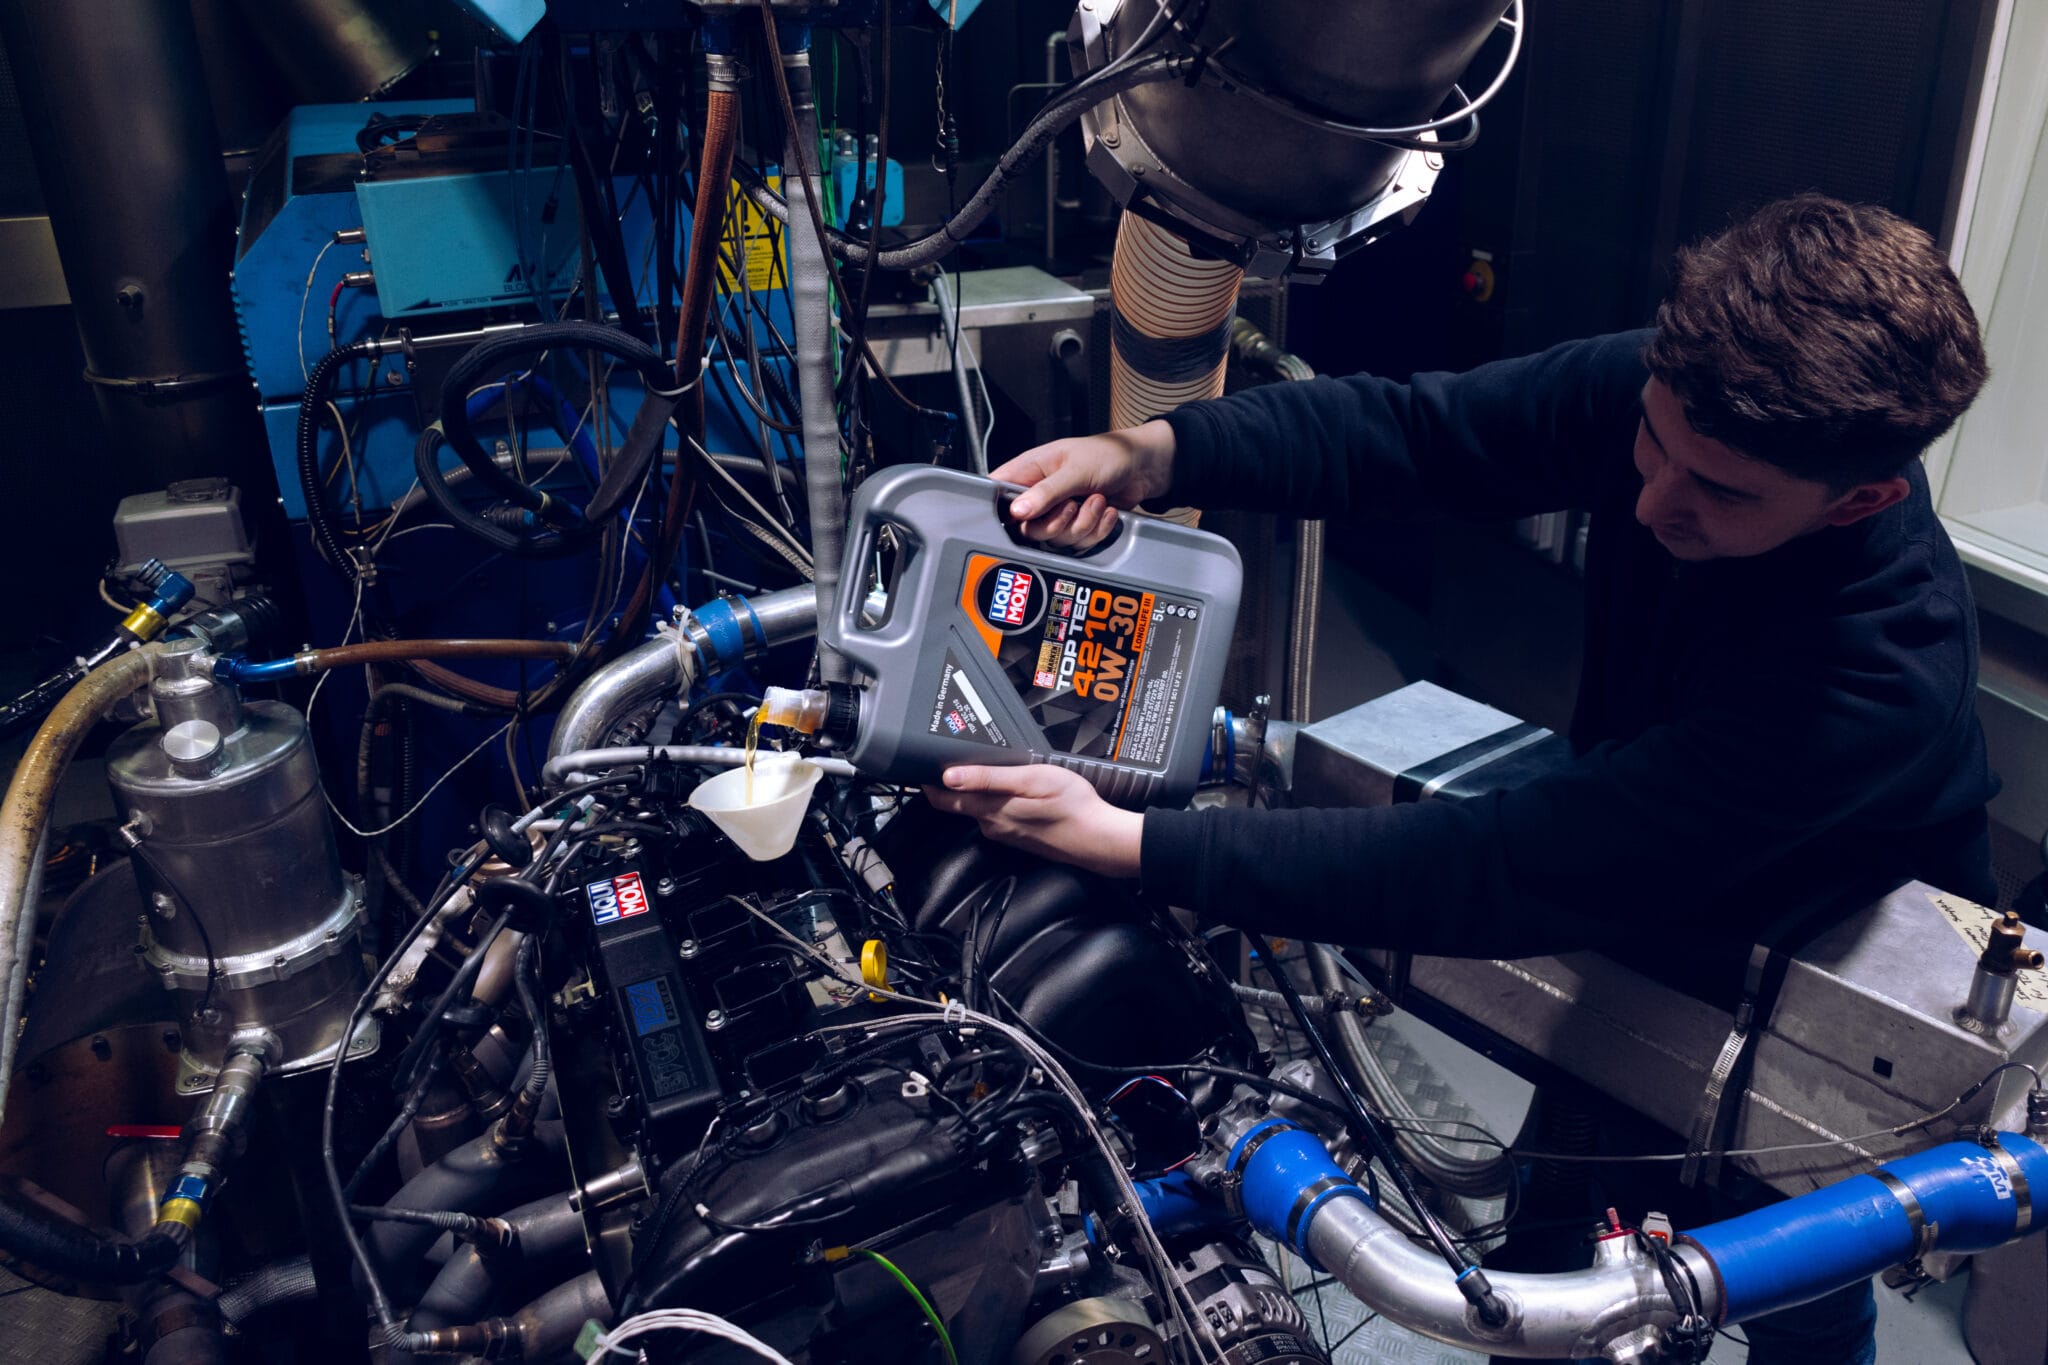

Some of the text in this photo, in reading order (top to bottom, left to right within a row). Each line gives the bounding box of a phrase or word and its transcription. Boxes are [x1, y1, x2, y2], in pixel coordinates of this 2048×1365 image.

[990, 571, 1015, 619] LIQUI
[1007, 574, 1030, 622] MOLY
[1055, 639, 1079, 692] TOP
[1068, 585, 1091, 636] TEC
[1073, 589, 1112, 698] 4210
[1134, 597, 1151, 648] LONGLIFE III
[1094, 596, 1139, 701] 0W-30
[929, 663, 954, 732] Made in Germany
[950, 710, 965, 729] MOLY
[960, 711, 970, 723] TEC
[944, 714, 959, 733] LIQUI
[967, 721, 977, 733] TOP
[1129, 742, 1138, 759] ACEA
[1136, 714, 1145, 731] BMW
[1135, 722, 1149, 760] MB-Freigabe
[1141, 737, 1152, 761] Porsche
[1150, 711, 1158, 722] VW
[1155, 751, 1163, 763] API
[1160, 725, 1169, 741] Iveco
[590, 880, 620, 923] LIQUI
[616, 874, 645, 916] MOLY
